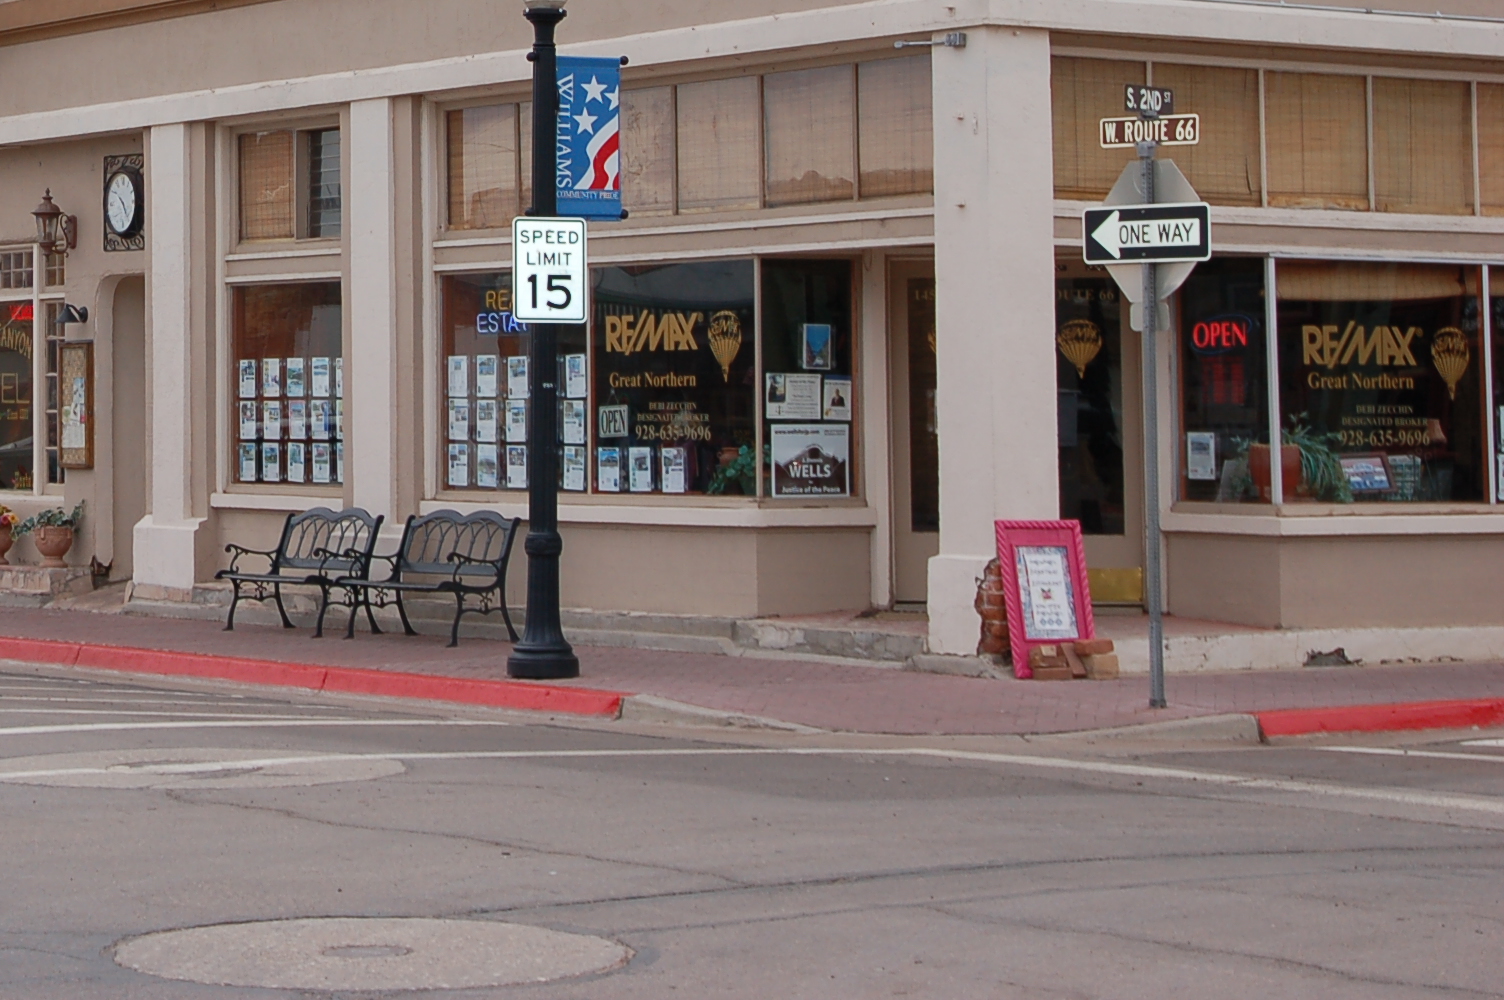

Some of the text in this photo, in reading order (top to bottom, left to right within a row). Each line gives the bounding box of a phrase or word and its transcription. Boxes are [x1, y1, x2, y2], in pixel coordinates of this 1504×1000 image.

[1126, 86, 1172, 112] S. 2ND ST
[556, 72, 574, 189] WILLIAMS
[1104, 119, 1195, 143] W. ROUTE 66
[556, 190, 619, 200] COMMUNITY PRIDE
[520, 229, 579, 245] SPEED
[1119, 223, 1194, 244] ONE WAY
[526, 251, 572, 266] LIMIT
[485, 290, 514, 310] RE
[527, 273, 572, 309] 15
[605, 309, 699, 356] RE/MAX
[1192, 321, 1249, 349] OPEN
[1302, 320, 1418, 370] RE/MAX
[609, 371, 697, 388] Great Northern
[1307, 372, 1414, 390] Great Northern
[601, 409, 626, 434] OPEN
[1342, 416, 1393, 426] DESIGNATED
[635, 424, 712, 441] 928-635-9696
[1340, 430, 1431, 447] 928-635-9696
[788, 463, 832, 479] WELLS
[781, 485, 841, 494] Justice of the Peace
